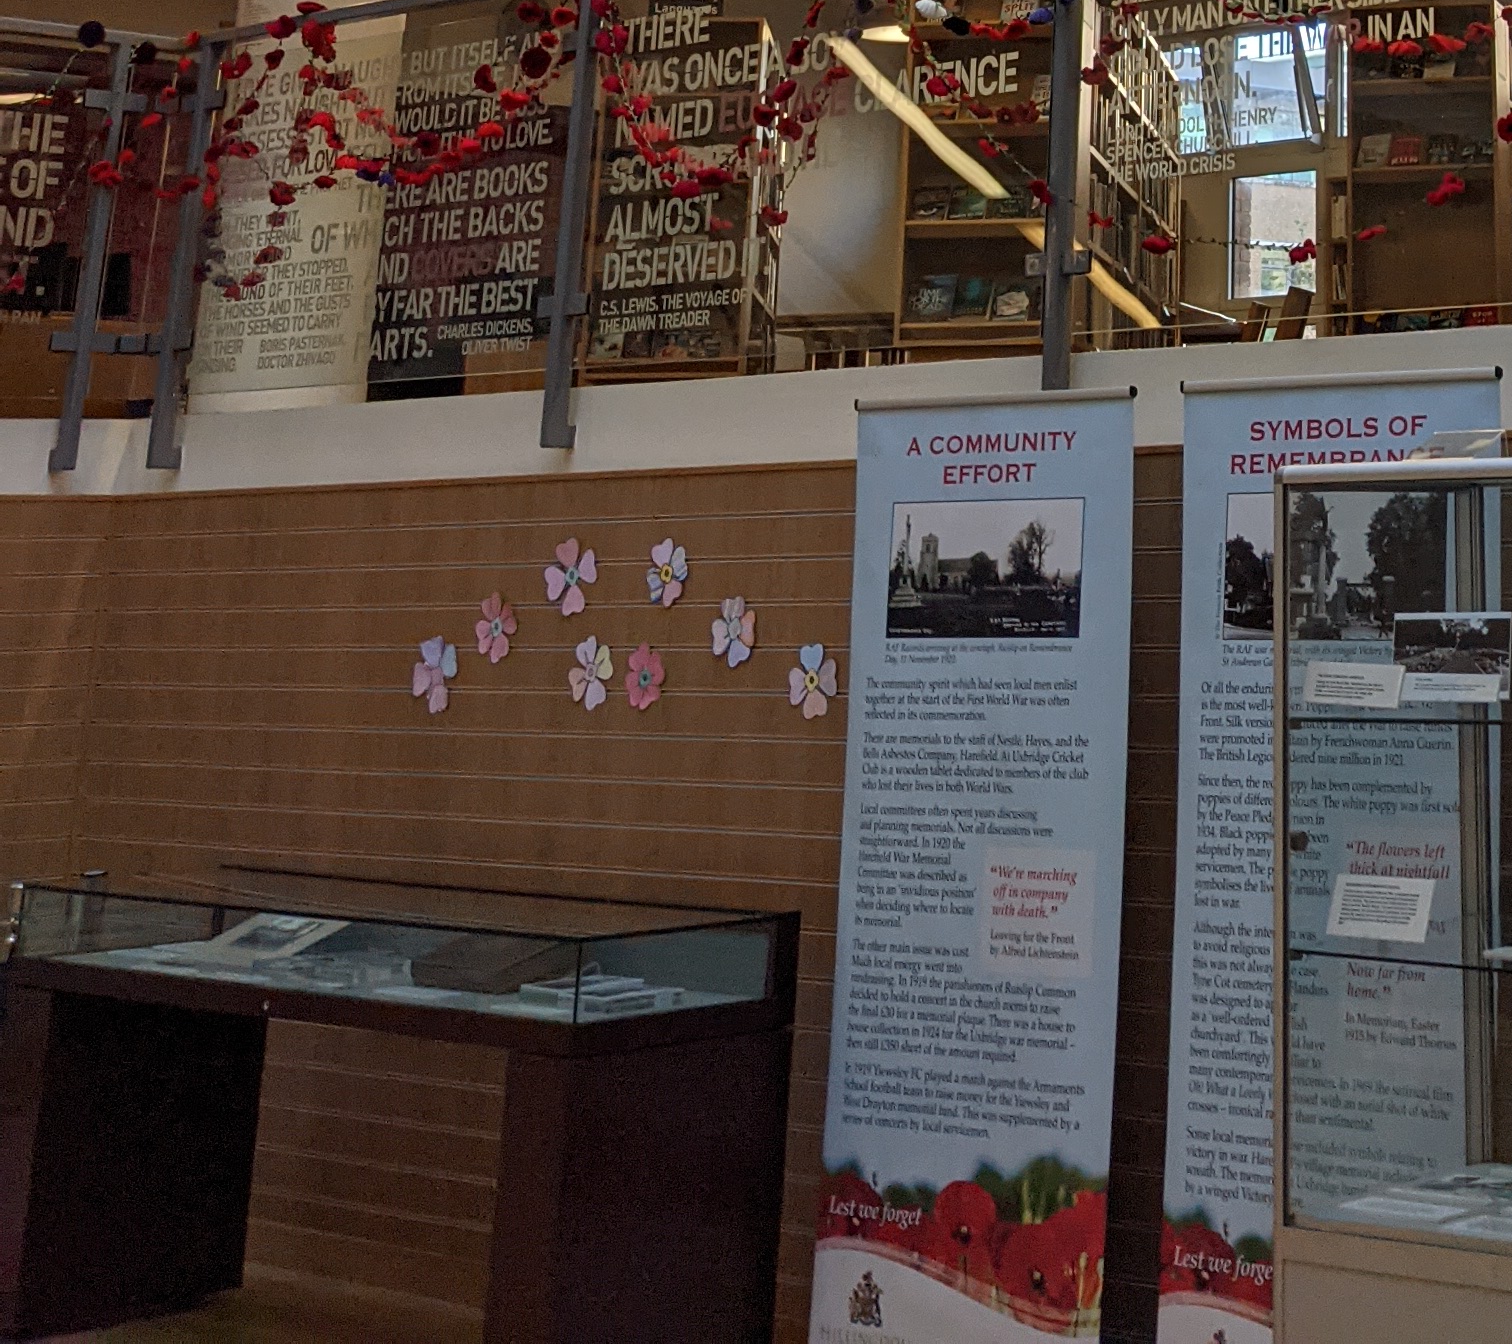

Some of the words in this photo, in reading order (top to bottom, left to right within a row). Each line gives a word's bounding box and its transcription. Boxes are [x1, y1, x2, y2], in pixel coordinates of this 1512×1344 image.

[623, 7, 711, 54] THERE
[1366, 12, 1391, 42] IN
[1396, 7, 1434, 39] AN
[10, 159, 64, 200] OF
[473, 158, 548, 198] BOOKS
[1133, 159, 1187, 181] WORLD
[1189, 153, 1235, 174] CRISIS
[605, 193, 720, 242] ALMOST
[602, 242, 735, 290] DESERVED
[437, 282, 478, 317] THE
[480, 277, 538, 313] BEST
[660, 294, 683, 310] THE
[685, 289, 730, 308] VOYAGE
[436, 321, 484, 339] CHARLES
[600, 317, 622, 334] THE
[623, 314, 656, 331] DAWN
[656, 308, 710, 328] TREADER
[461, 337, 498, 355] OLIVER
[499, 335, 532, 352] TWIST
[906, 437, 922, 455] A
[929, 430, 1077, 454] COMMUNITY
[1250, 416, 1379, 441] SYMBOLS
[1387, 415, 1427, 436] OF
[942, 462, 1037, 484] EFFORT
[828, 1194, 856, 1216] Lest
[856, 1203, 879, 1219] we
[880, 1201, 922, 1230] forget
[1173, 1244, 1203, 1270] Lest
[1207, 1255, 1231, 1273] we
[1233, 1252, 1273, 1285] forge
